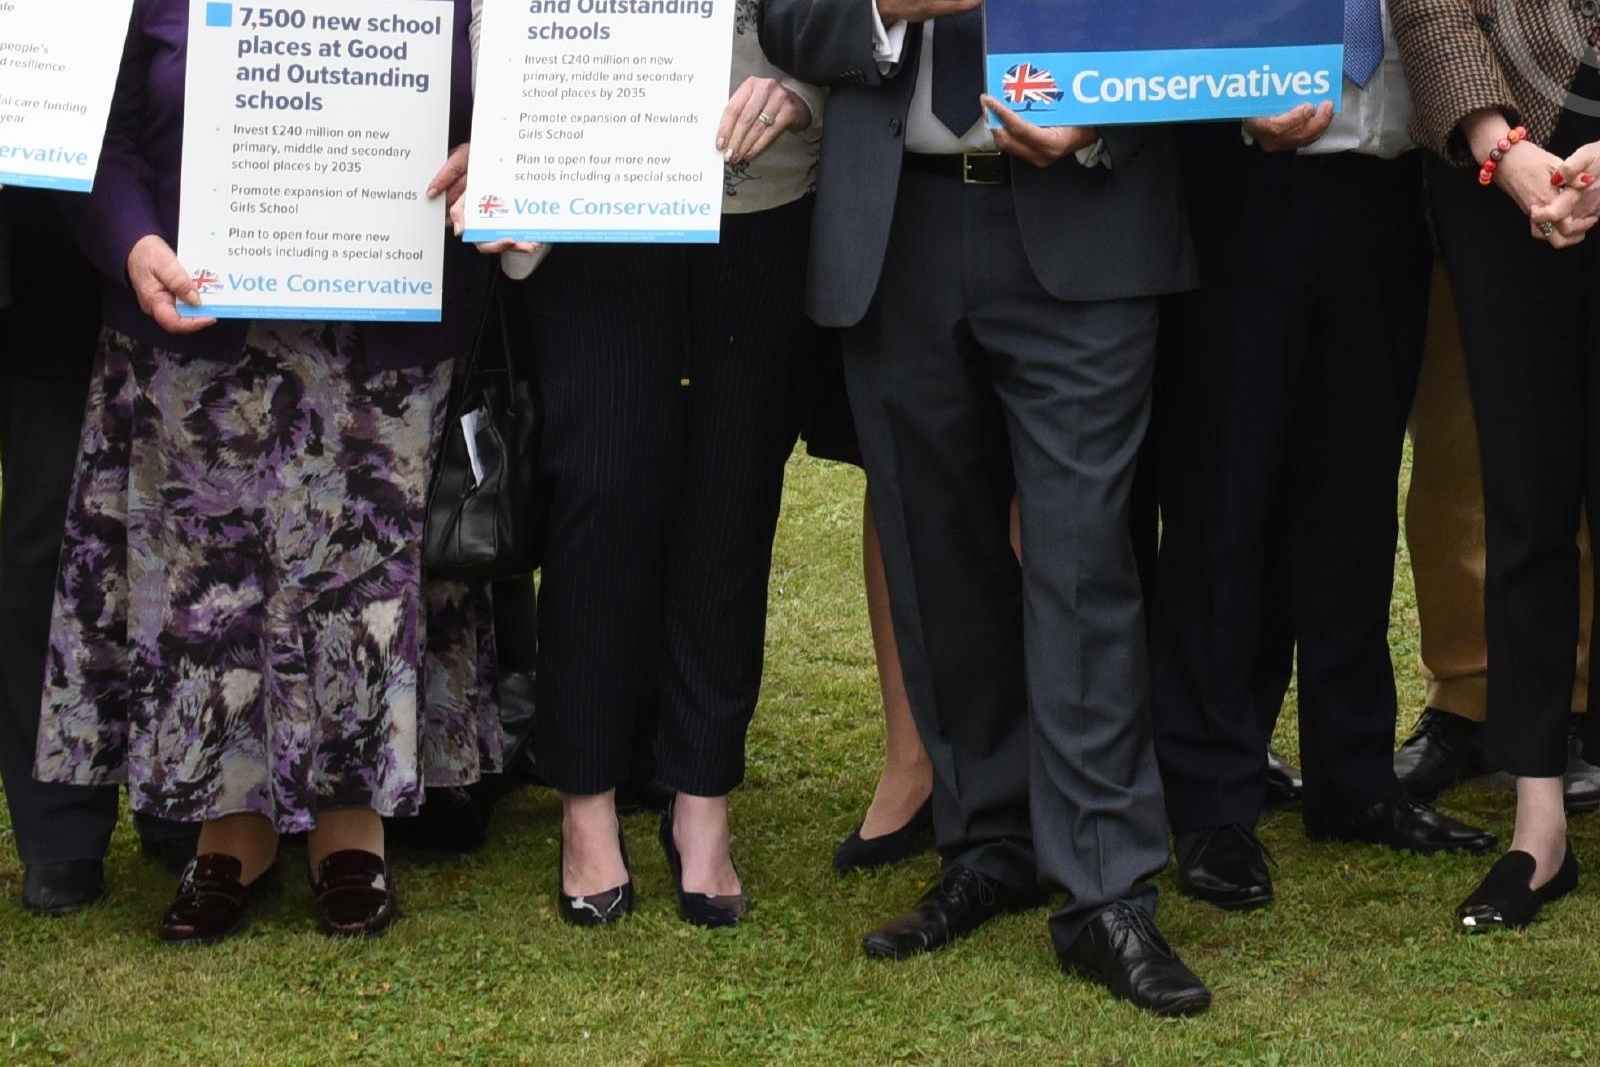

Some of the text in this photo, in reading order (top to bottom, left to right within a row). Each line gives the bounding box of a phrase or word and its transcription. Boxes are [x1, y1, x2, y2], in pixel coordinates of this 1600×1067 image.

[239, 7, 441, 36] 7,500 new school
[527, 21, 611, 40] schools
[237, 34, 408, 61] places at Good
[236, 63, 430, 93] and Outstanding
[1072, 65, 1330, 104] Conservatives
[235, 89, 323, 111] schools
[231, 158, 362, 175] school places by 2035
[228, 273, 433, 296] Vote Conservative
